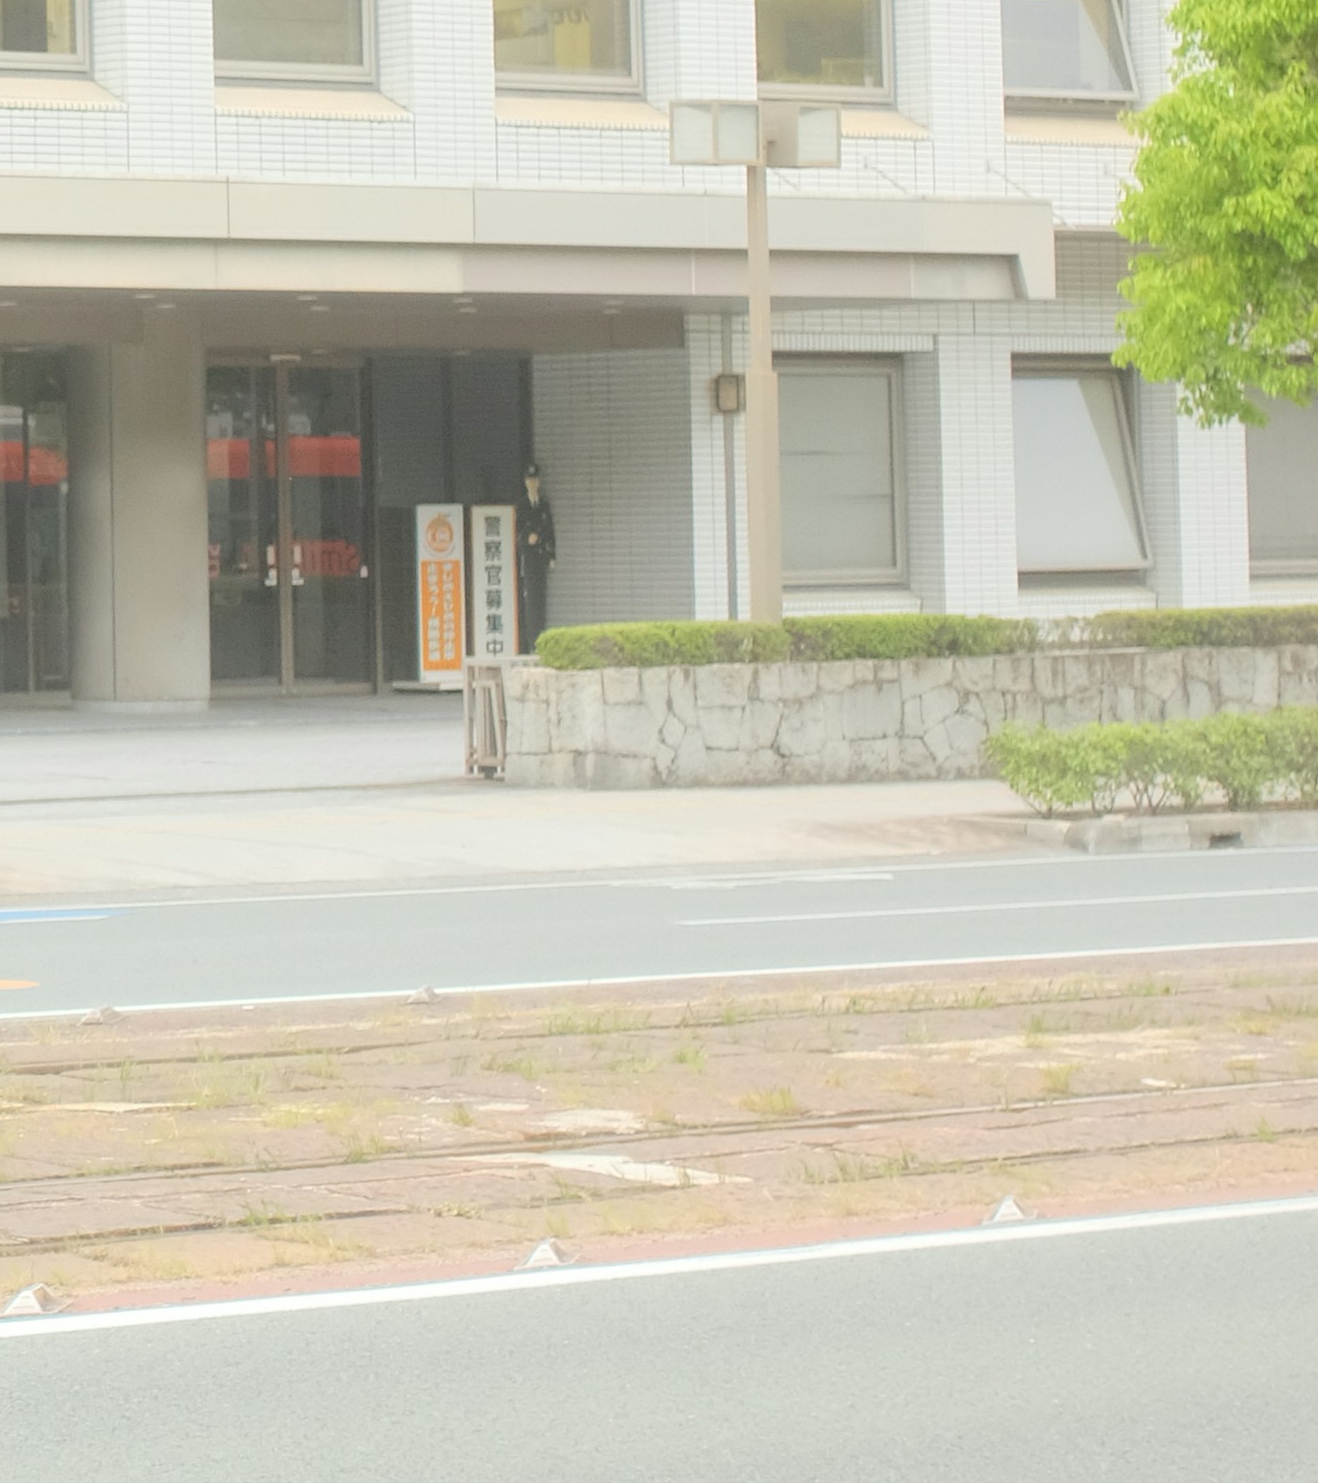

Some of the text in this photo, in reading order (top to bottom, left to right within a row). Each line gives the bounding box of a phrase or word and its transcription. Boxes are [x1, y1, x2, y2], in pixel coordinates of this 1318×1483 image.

[484, 516, 504, 658] 警察官募集中
